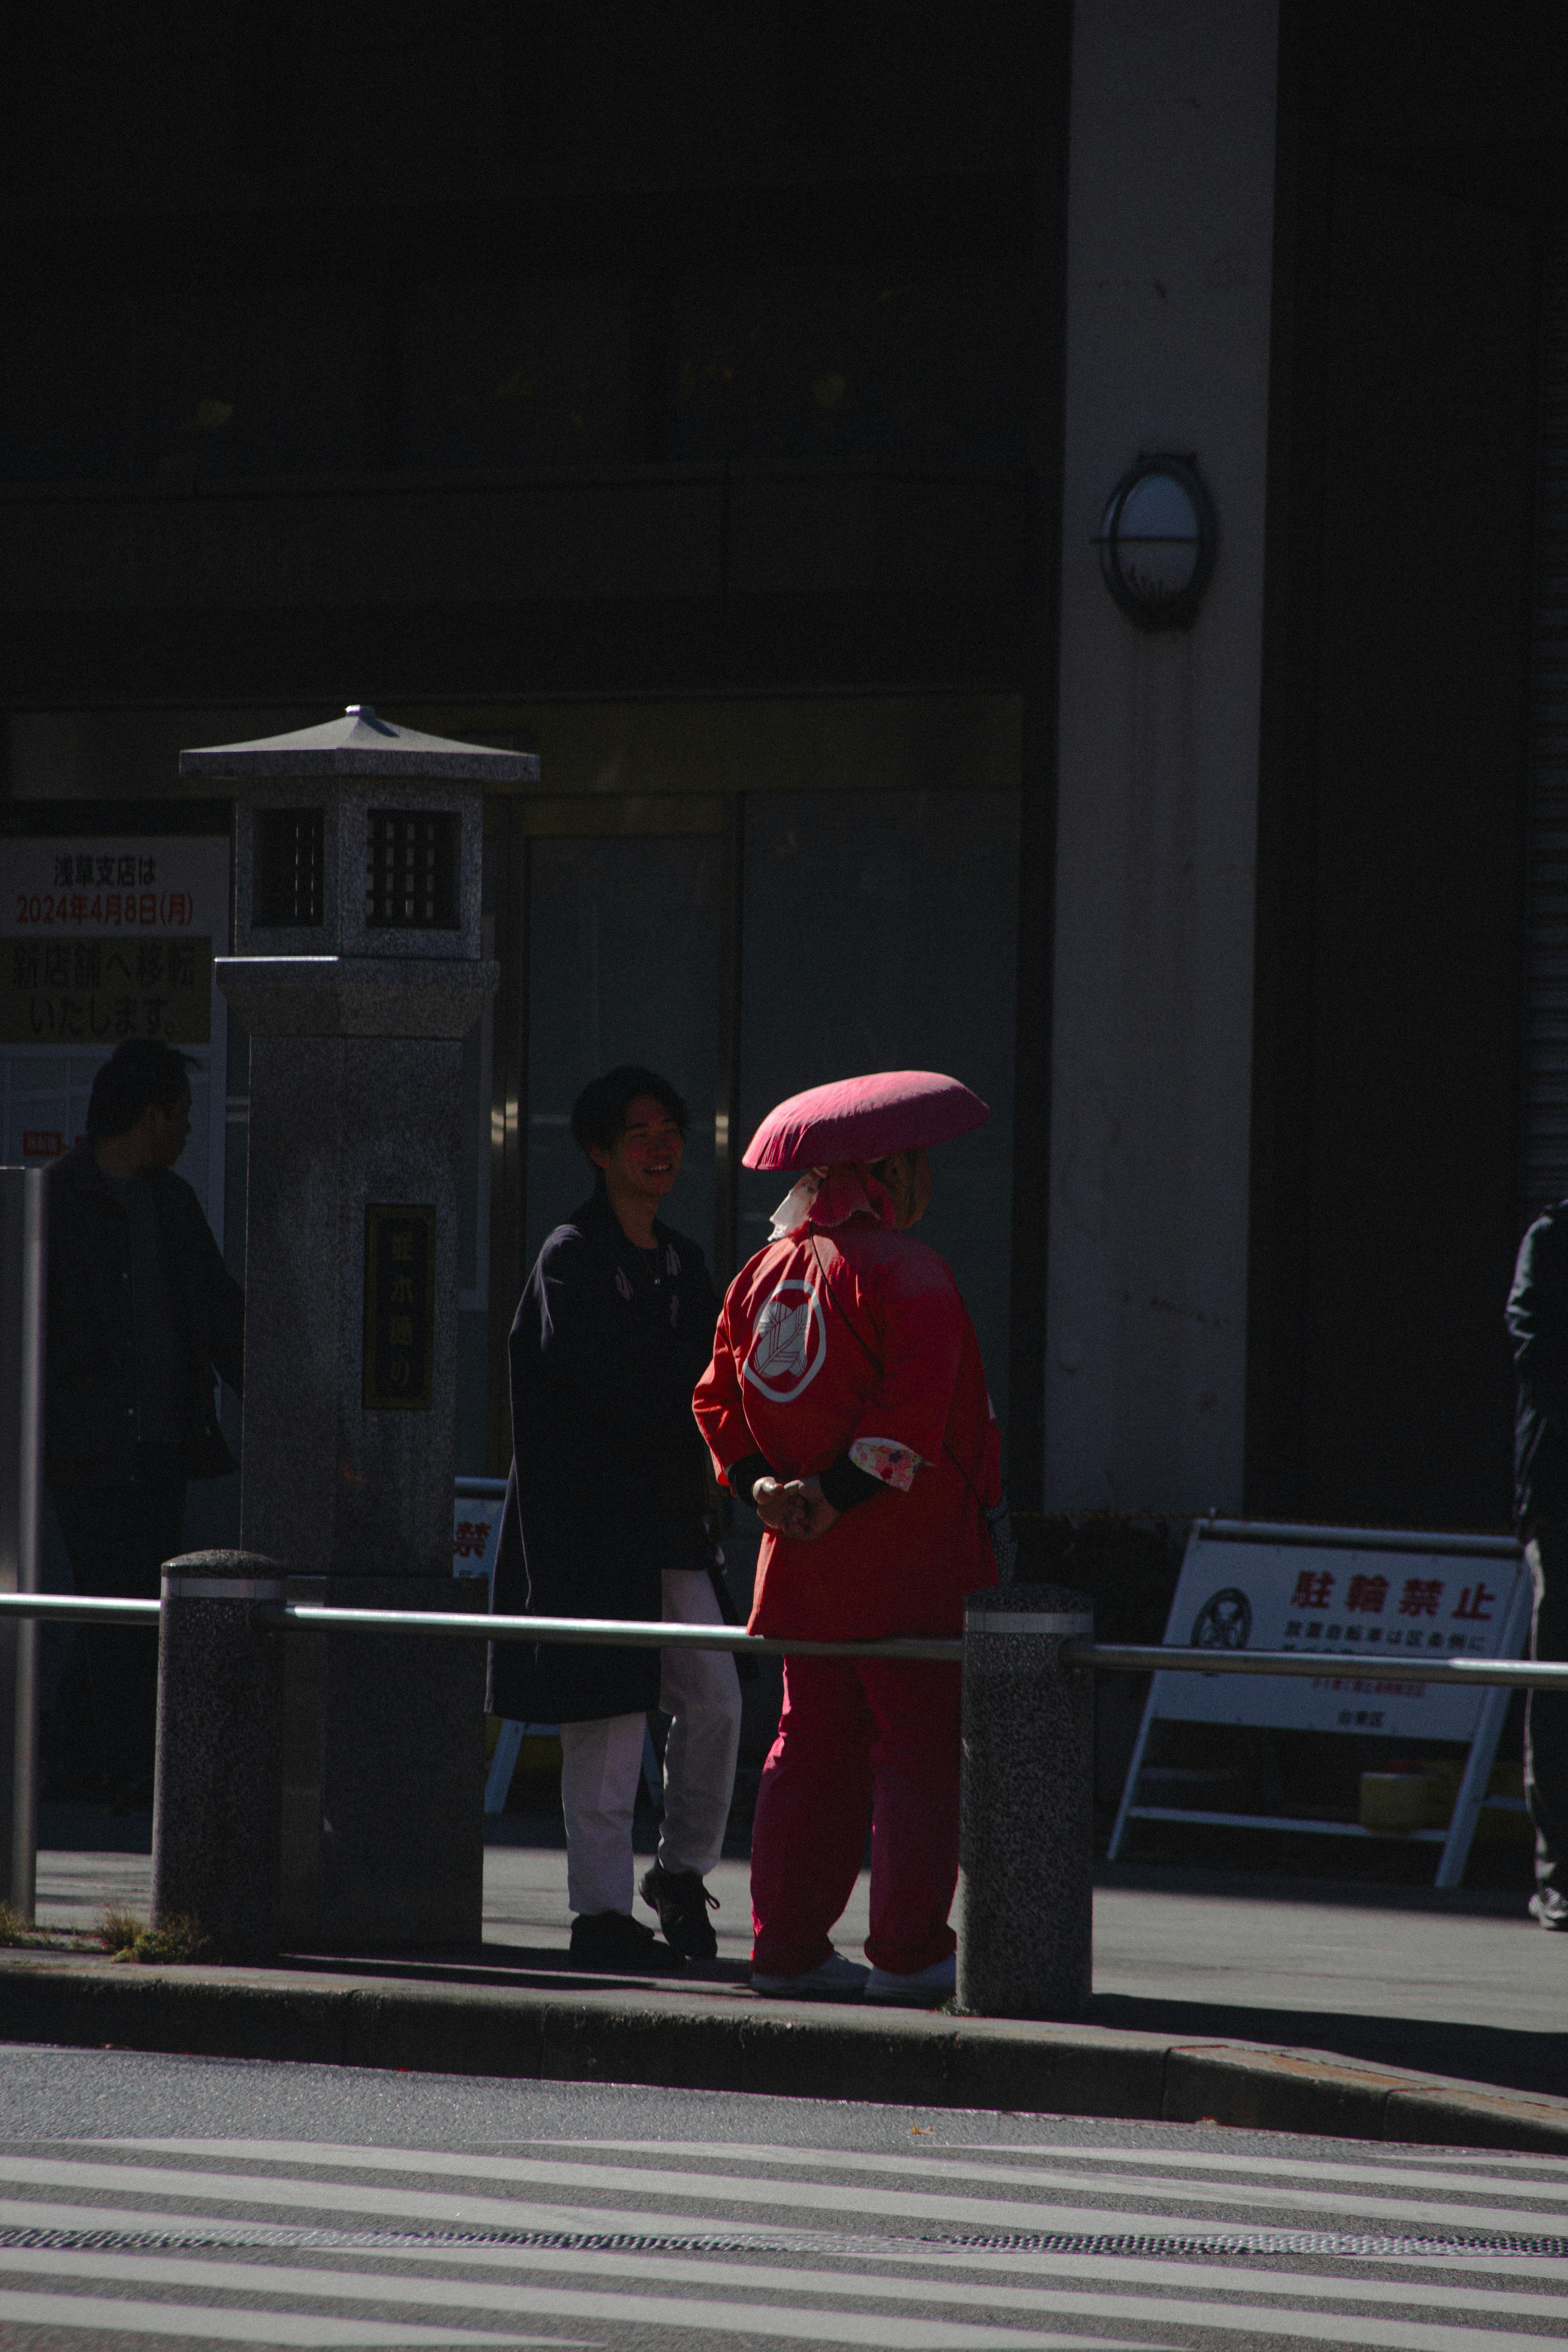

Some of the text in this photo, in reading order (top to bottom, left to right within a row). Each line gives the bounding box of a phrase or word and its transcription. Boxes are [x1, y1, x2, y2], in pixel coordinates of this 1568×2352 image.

[54, 855, 155, 887] 浅草支店は
[16, 892, 194, 926] 2024年4月8日(月)
[389, 1232, 414, 1387] 並木通り
[1291, 1571, 1495, 1621] 駐輪禁止
